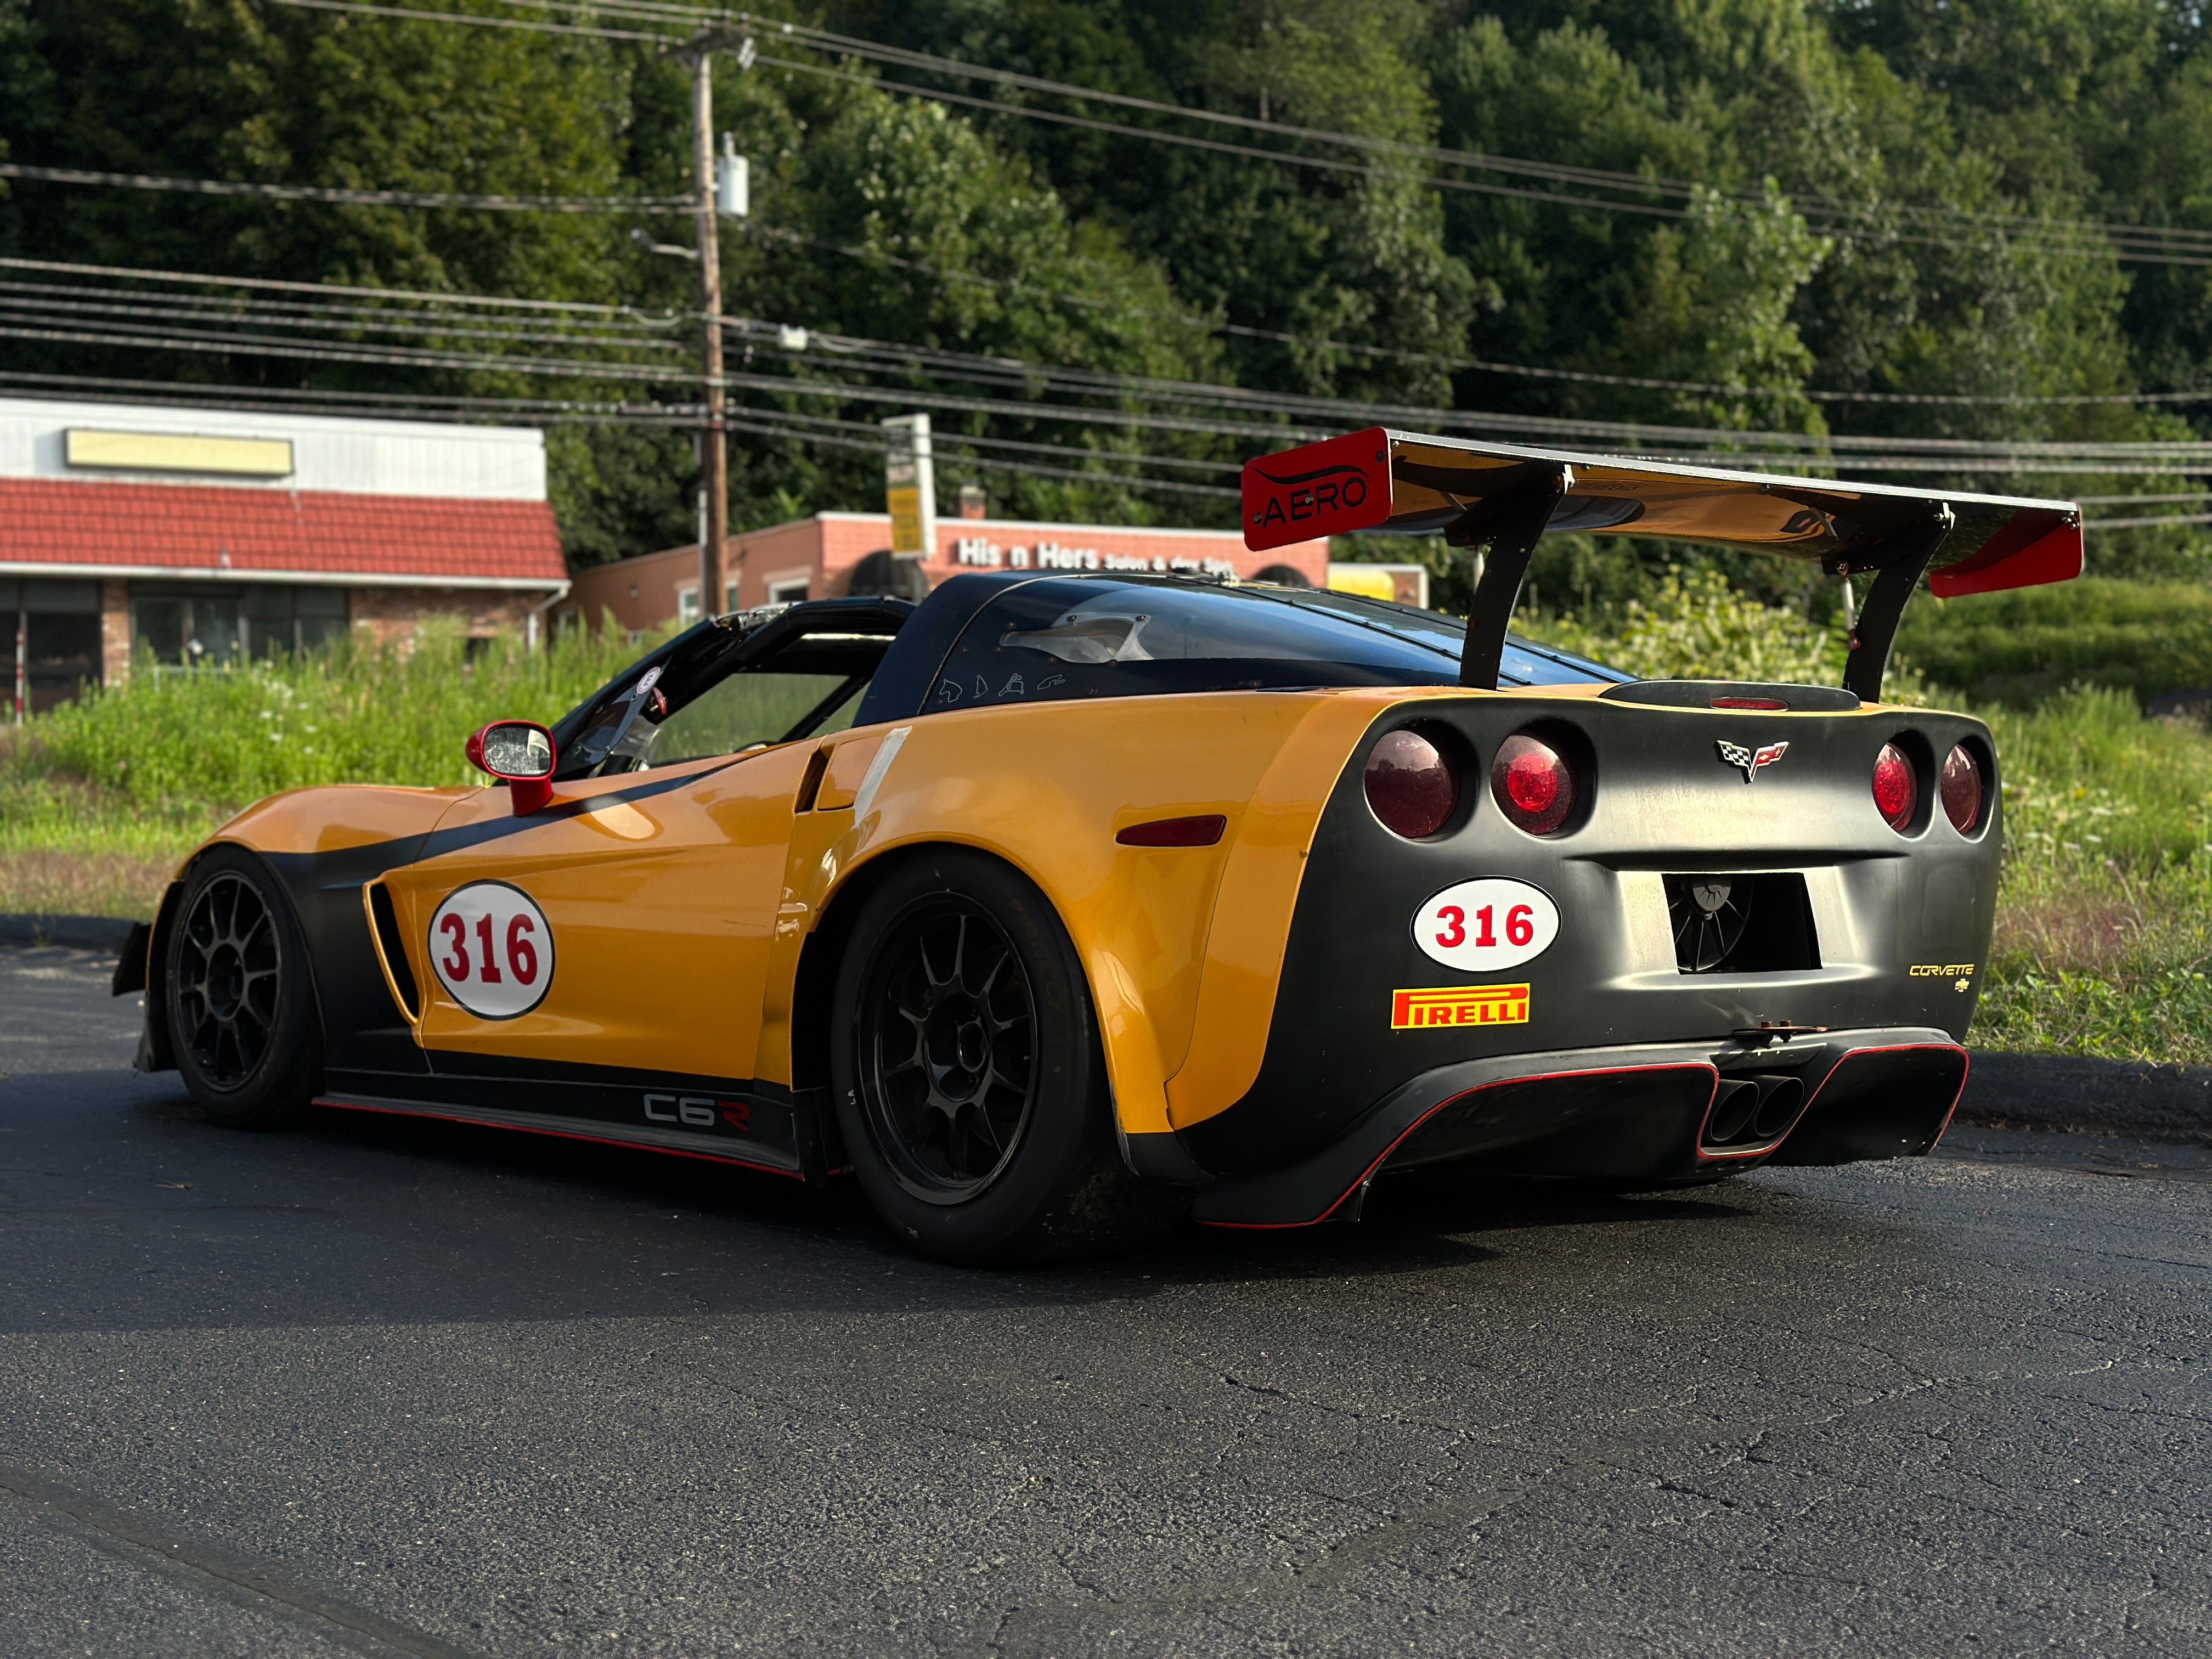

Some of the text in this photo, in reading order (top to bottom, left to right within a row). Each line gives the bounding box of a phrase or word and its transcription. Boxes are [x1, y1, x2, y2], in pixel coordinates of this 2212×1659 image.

[1263, 477, 1367, 528] AERO
[958, 537, 1002, 566] His
[1010, 546, 1029, 567] n
[1037, 541, 1098, 569] Hers
[1435, 904, 1534, 948] 316
[440, 913, 538, 986] 316
[1909, 964, 1974, 976] CORVETTE
[1393, 987, 1528, 1026] PIRELLI
[644, 1093, 752, 1132] C6R
